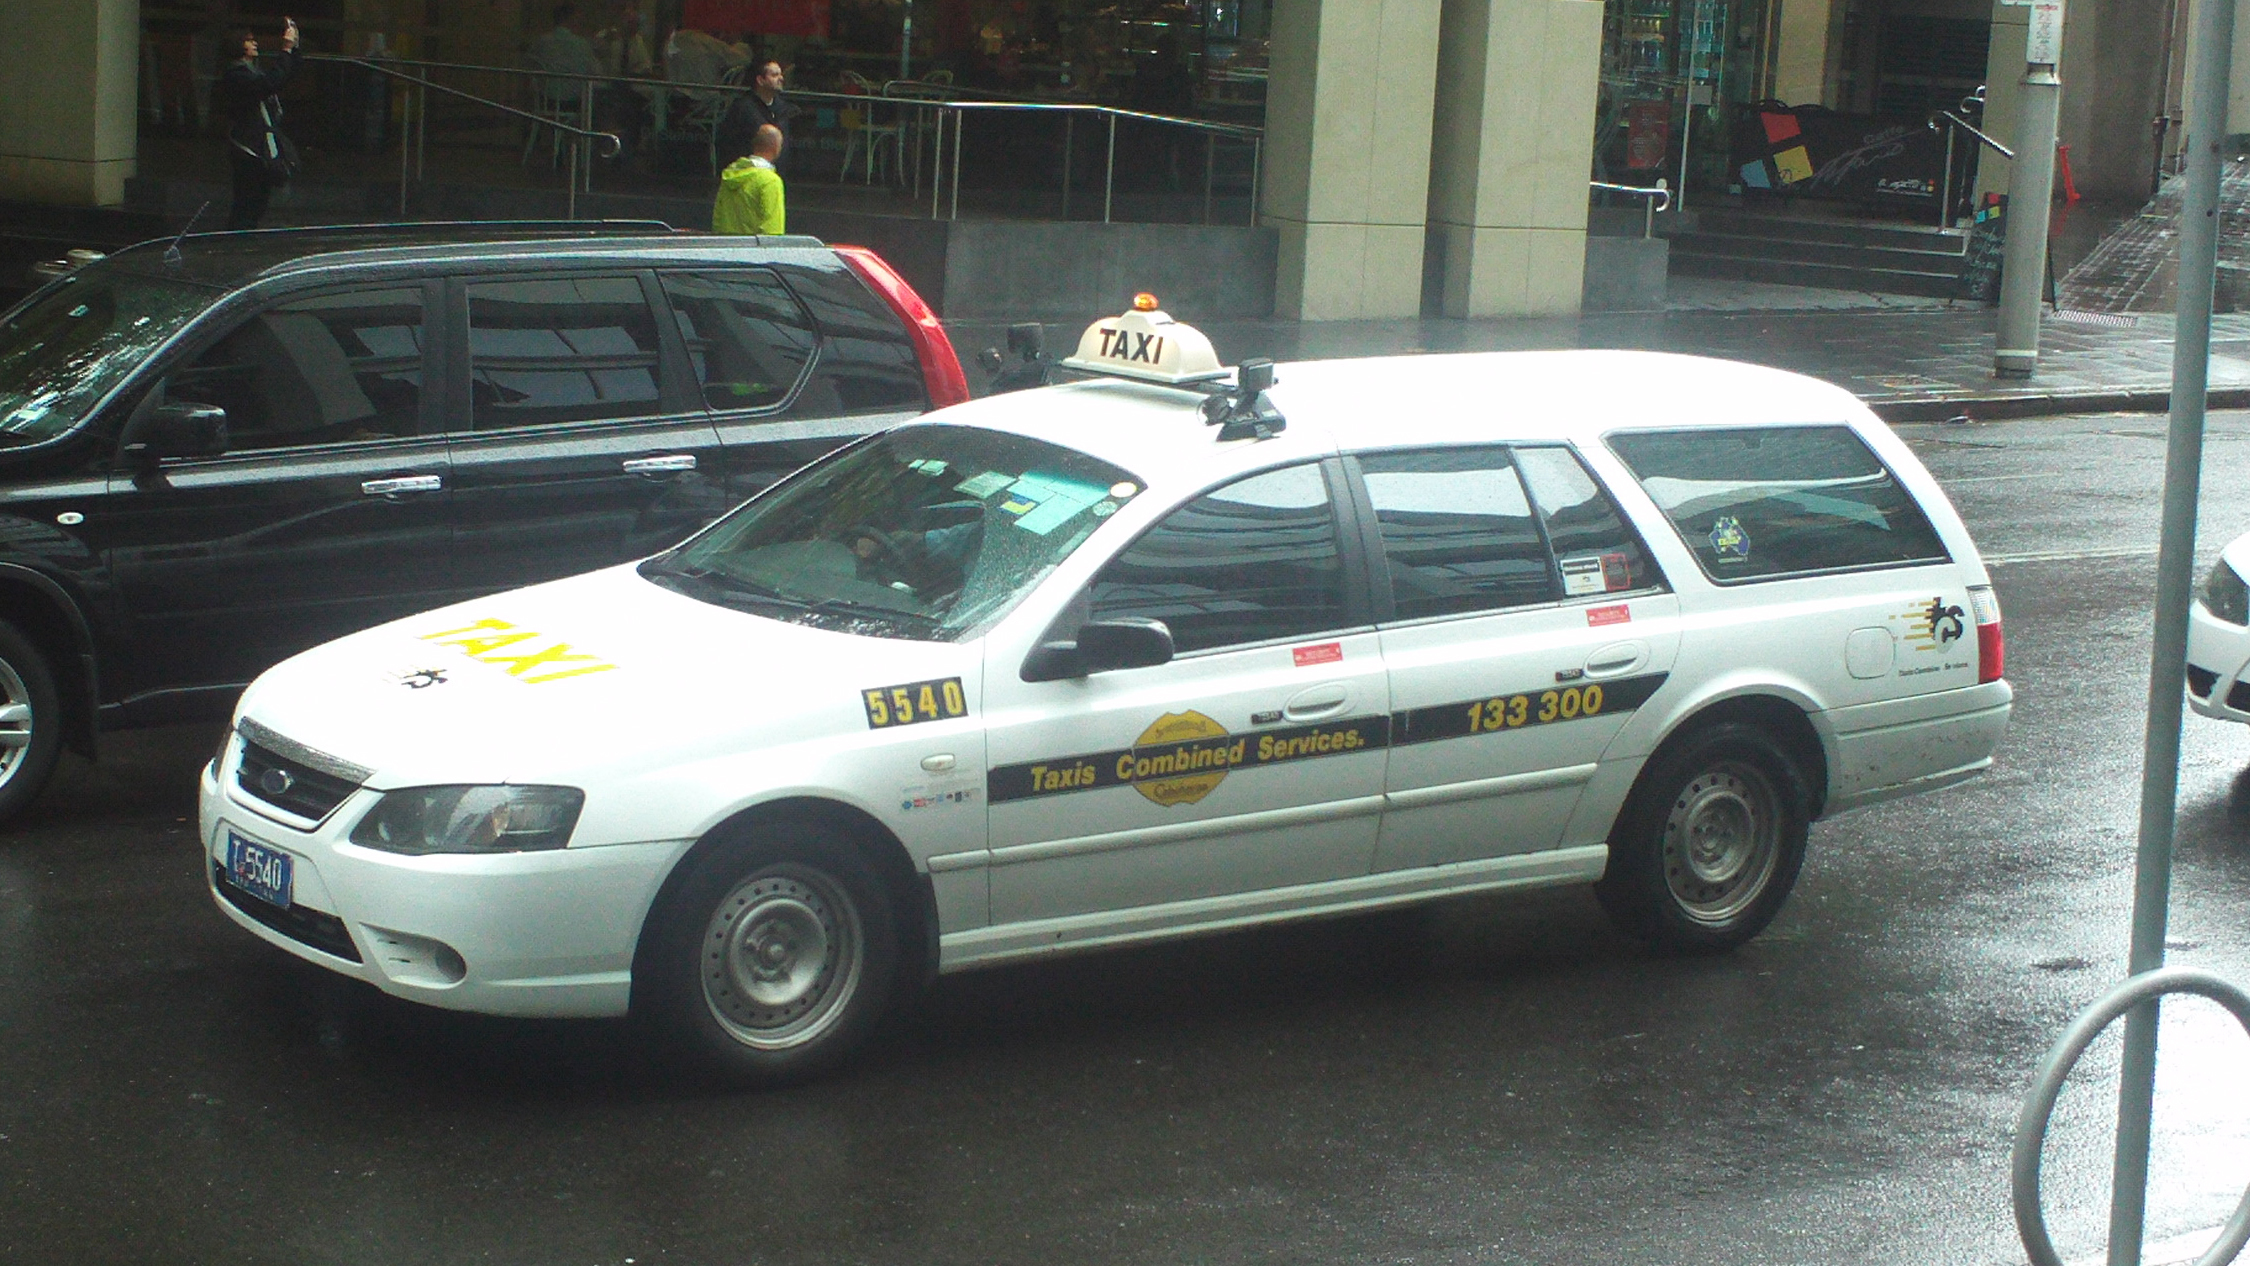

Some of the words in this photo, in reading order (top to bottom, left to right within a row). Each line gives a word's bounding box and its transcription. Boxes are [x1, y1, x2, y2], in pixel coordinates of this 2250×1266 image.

[1098, 327, 1165, 365] TAXI
[416, 617, 620, 685] TAXI
[867, 680, 964, 728] 5540
[1467, 693, 1528, 732] 133
[1538, 684, 1604, 722] 300
[1031, 760, 1096, 791] Taxis
[1116, 742, 1246, 781] Combined
[1257, 728, 1366, 761] Services.
[245, 846, 282, 891] 5540
